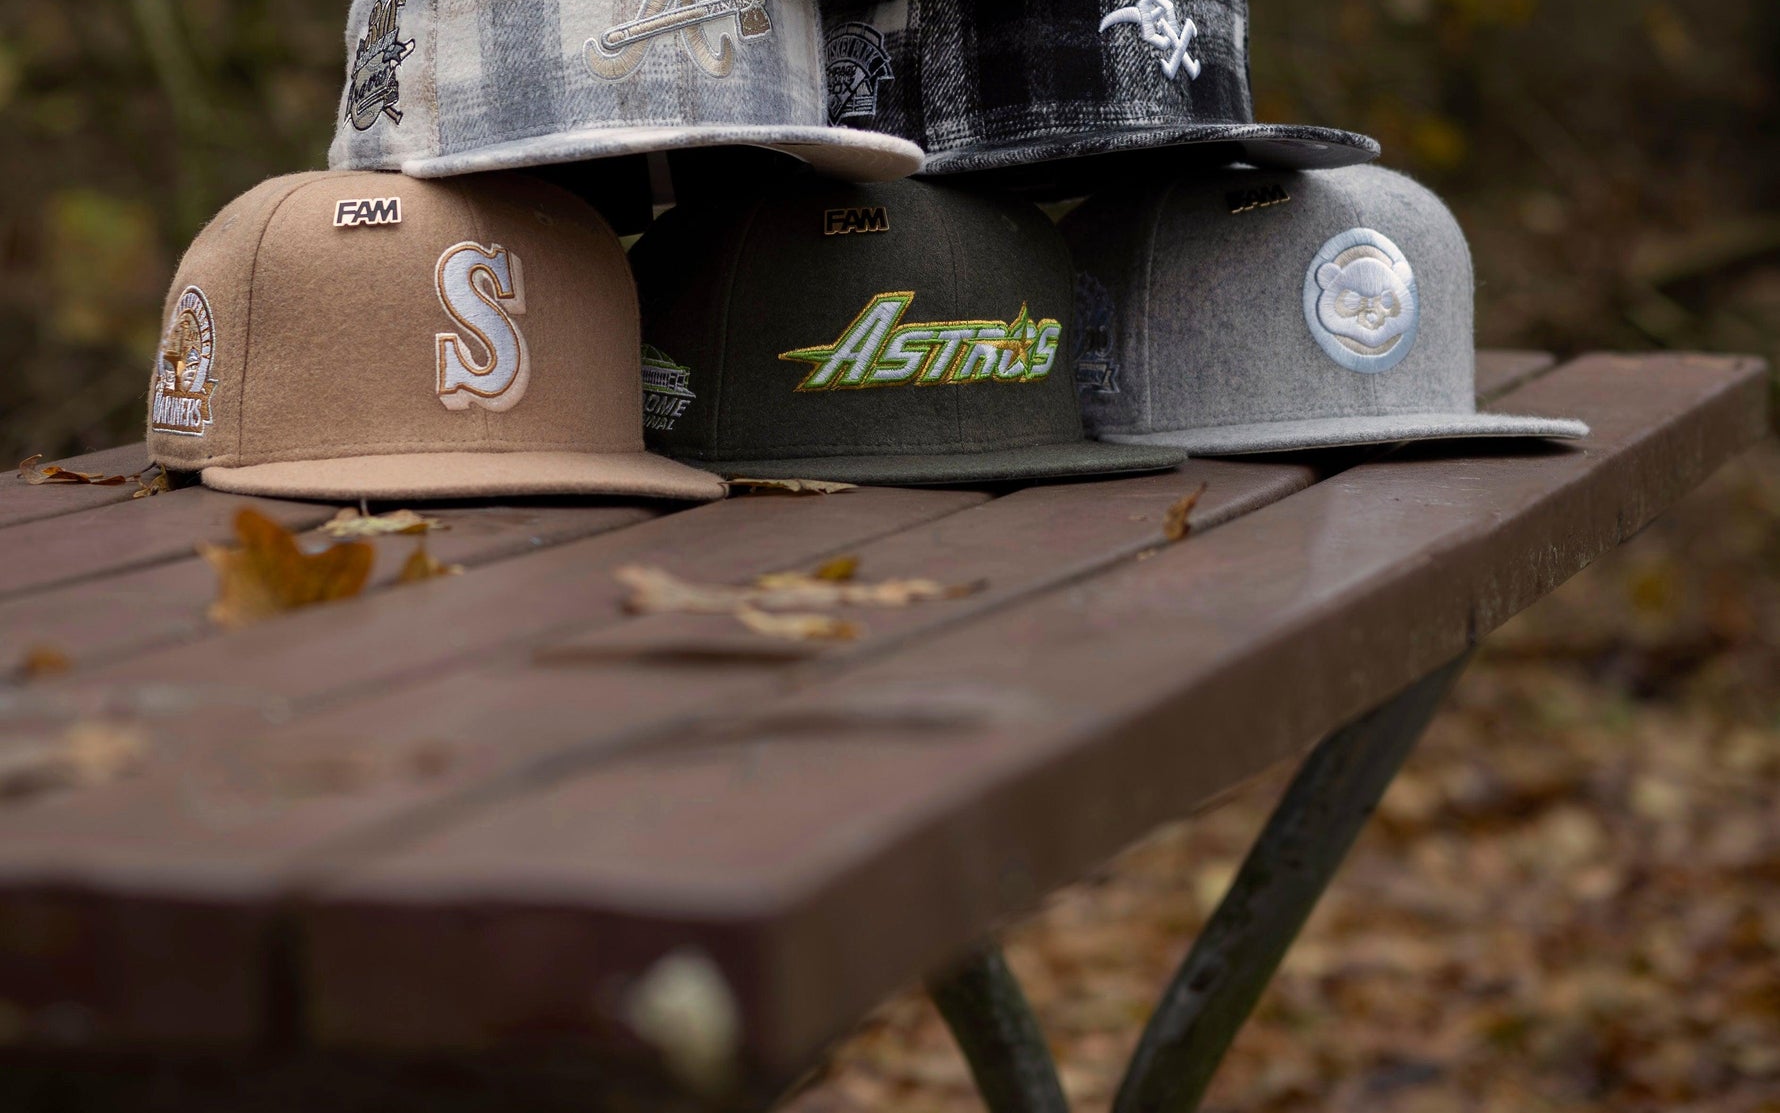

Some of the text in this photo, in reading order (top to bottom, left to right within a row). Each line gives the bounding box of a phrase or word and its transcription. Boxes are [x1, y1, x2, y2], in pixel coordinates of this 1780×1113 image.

[334, 198, 400, 225] FAM
[825, 207, 888, 234] FAM
[435, 240, 530, 413] S
[642, 393, 692, 418] OME
